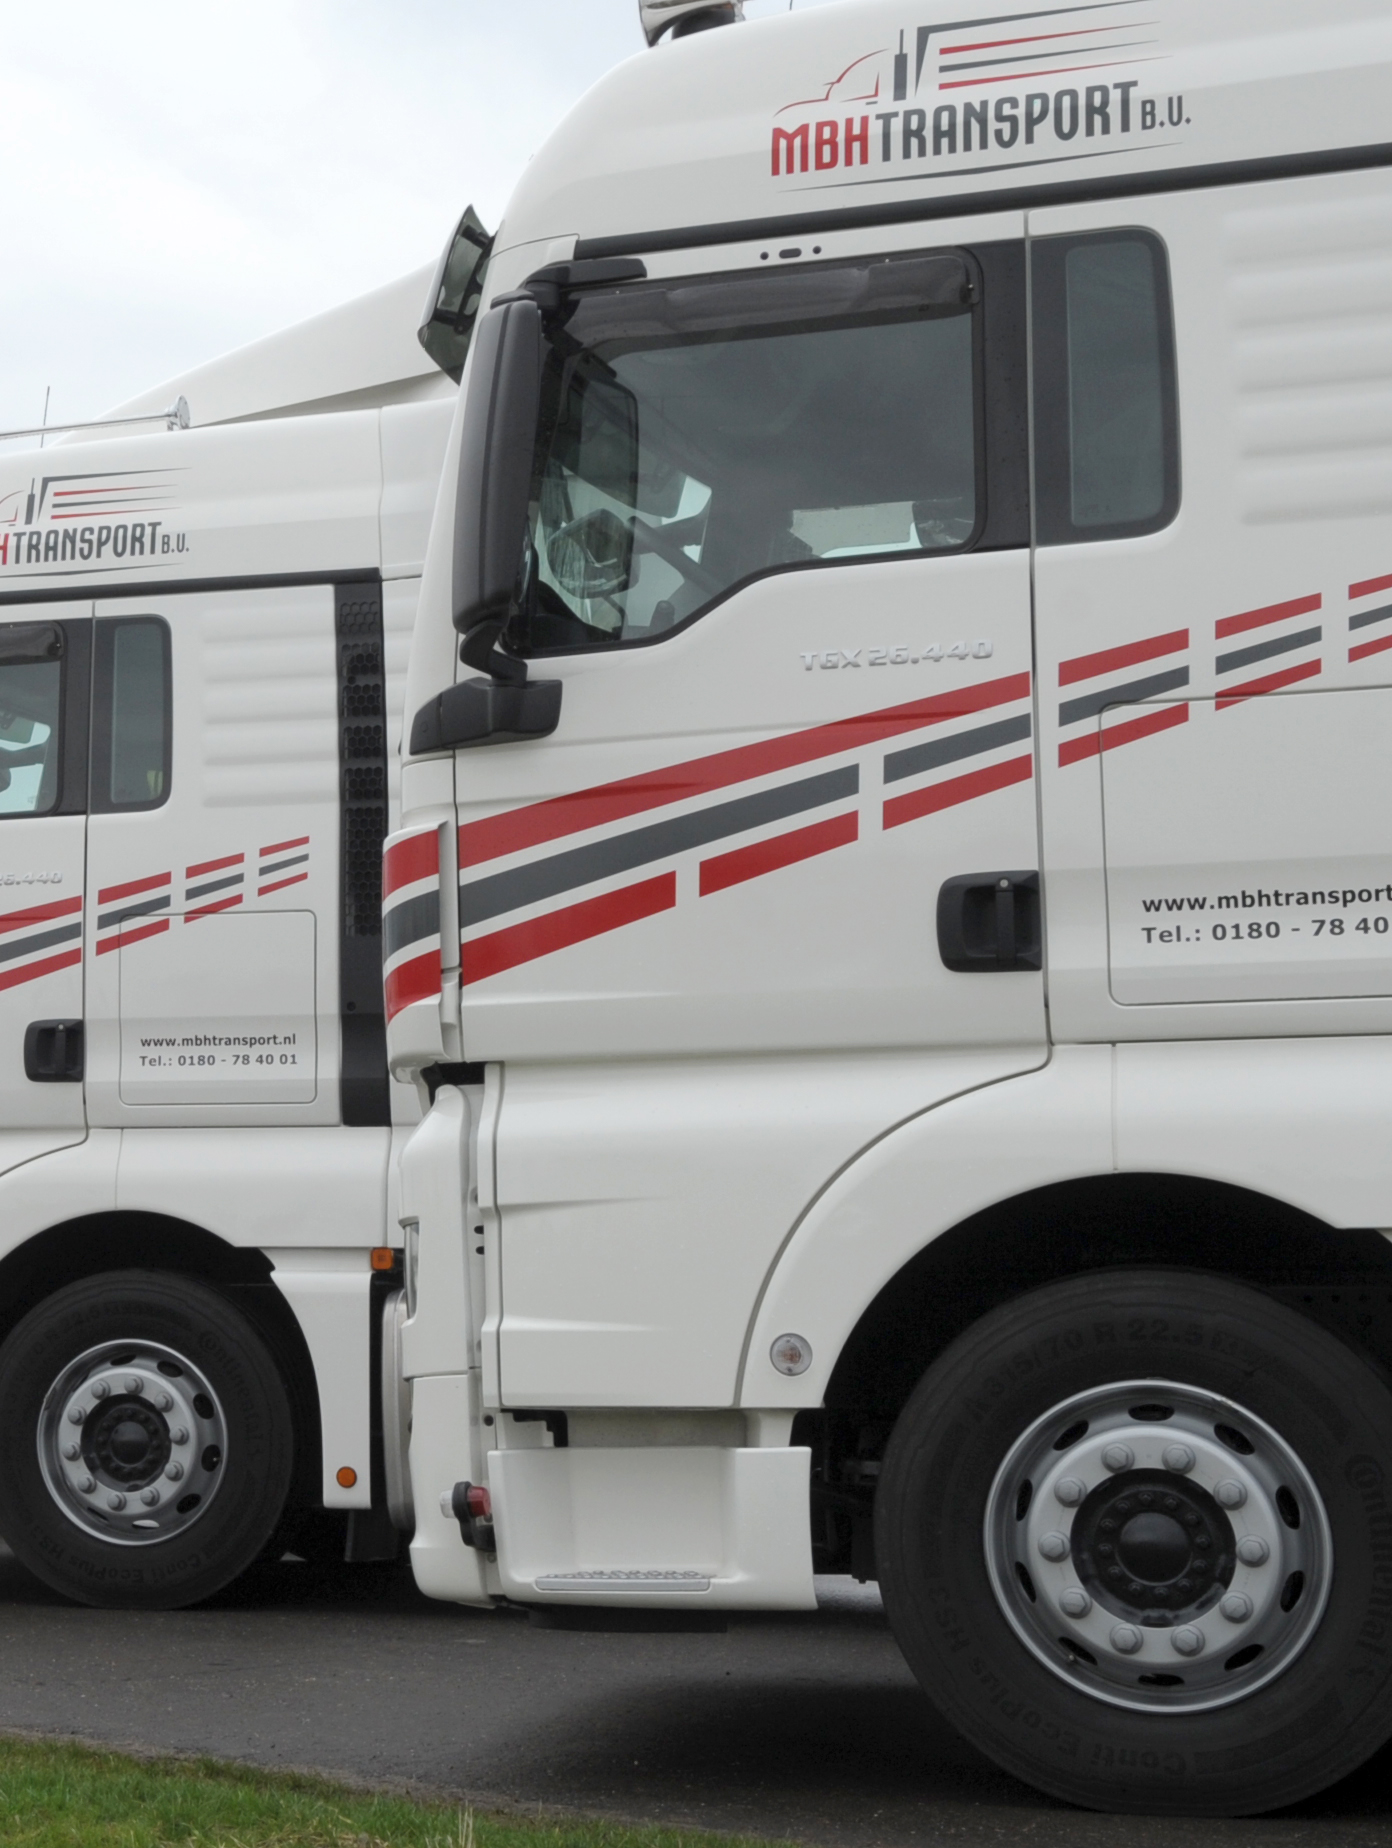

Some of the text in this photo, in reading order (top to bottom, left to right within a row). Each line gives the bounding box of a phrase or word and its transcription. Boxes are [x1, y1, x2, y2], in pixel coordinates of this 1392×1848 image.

[800, 639, 994, 672] TGX 26.440
[1141, 925, 1202, 944] Tel.:
[1211, 921, 1281, 941] 0180
[1311, 918, 1345, 937] 78
[1354, 916, 1390, 935] 40
[140, 1033, 296, 1049] www.mbhtransport.nl
[139, 1055, 173, 1067] Tel.:
[177, 1054, 216, 1067] 0180
[231, 1054, 251, 1066] 78
[255, 1053, 275, 1065] 40
[279, 1053, 298, 1065] 01
[1127, 1318, 1204, 1346] 22.5
